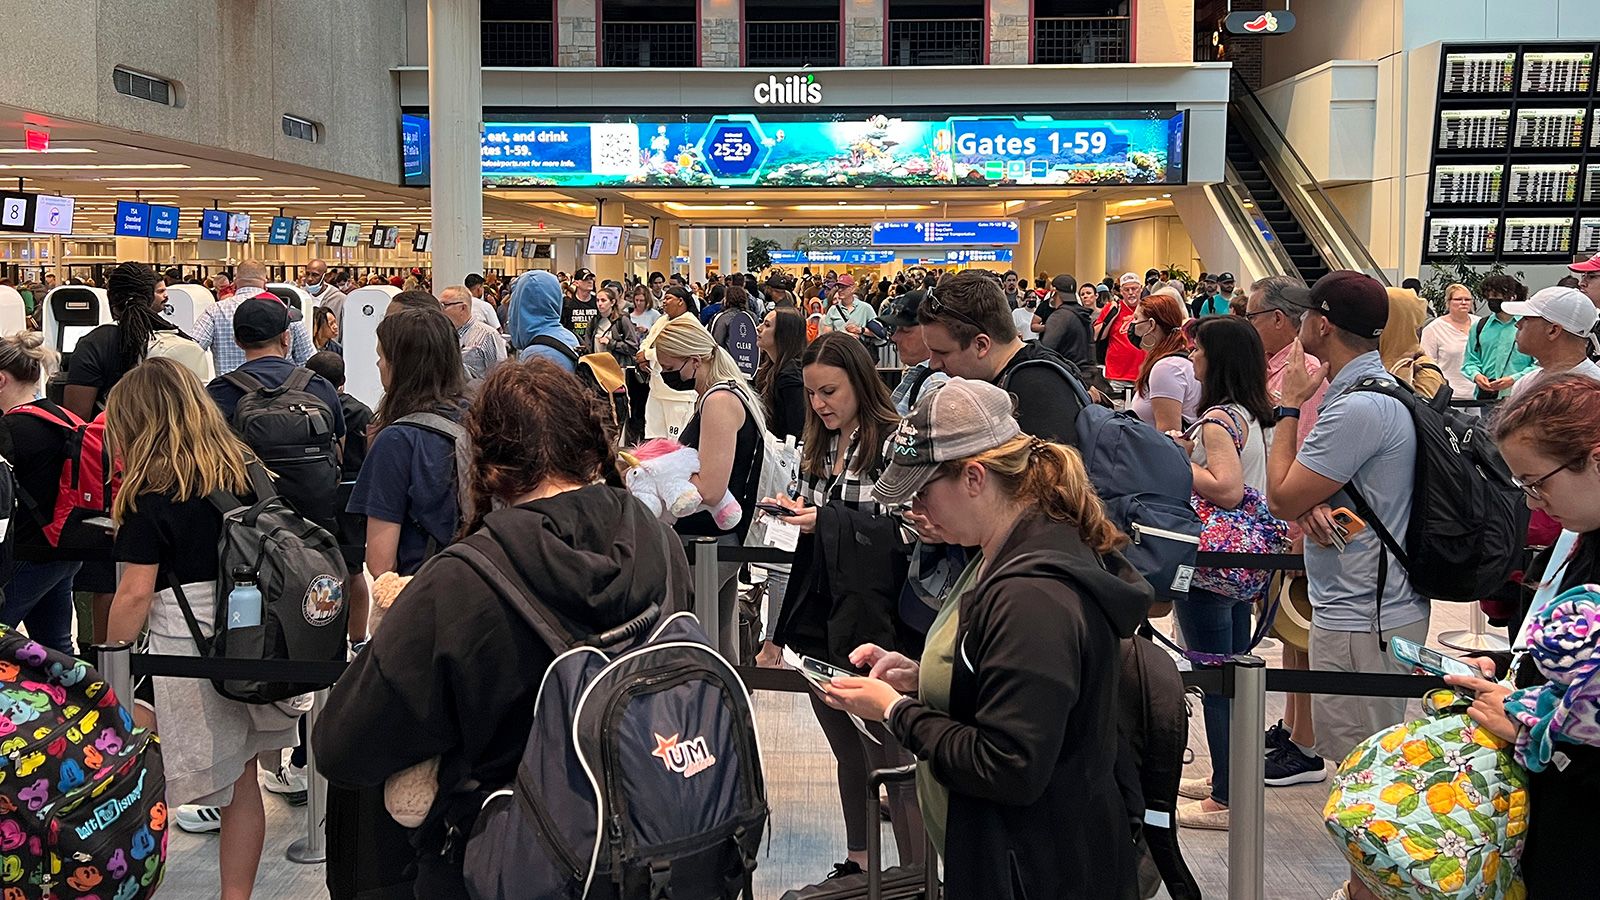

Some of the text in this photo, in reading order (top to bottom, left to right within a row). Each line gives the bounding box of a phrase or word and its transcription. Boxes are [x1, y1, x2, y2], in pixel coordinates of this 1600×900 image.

[754, 74, 822, 104] chili's
[488, 131, 569, 143] eat, and drink
[957, 132, 1107, 155] Gates 1-59
[714, 143, 752, 156] 25-29
[11, 204, 18, 219] 8
[736, 342, 752, 351] CLEAR
[668, 741, 708, 768] UM
